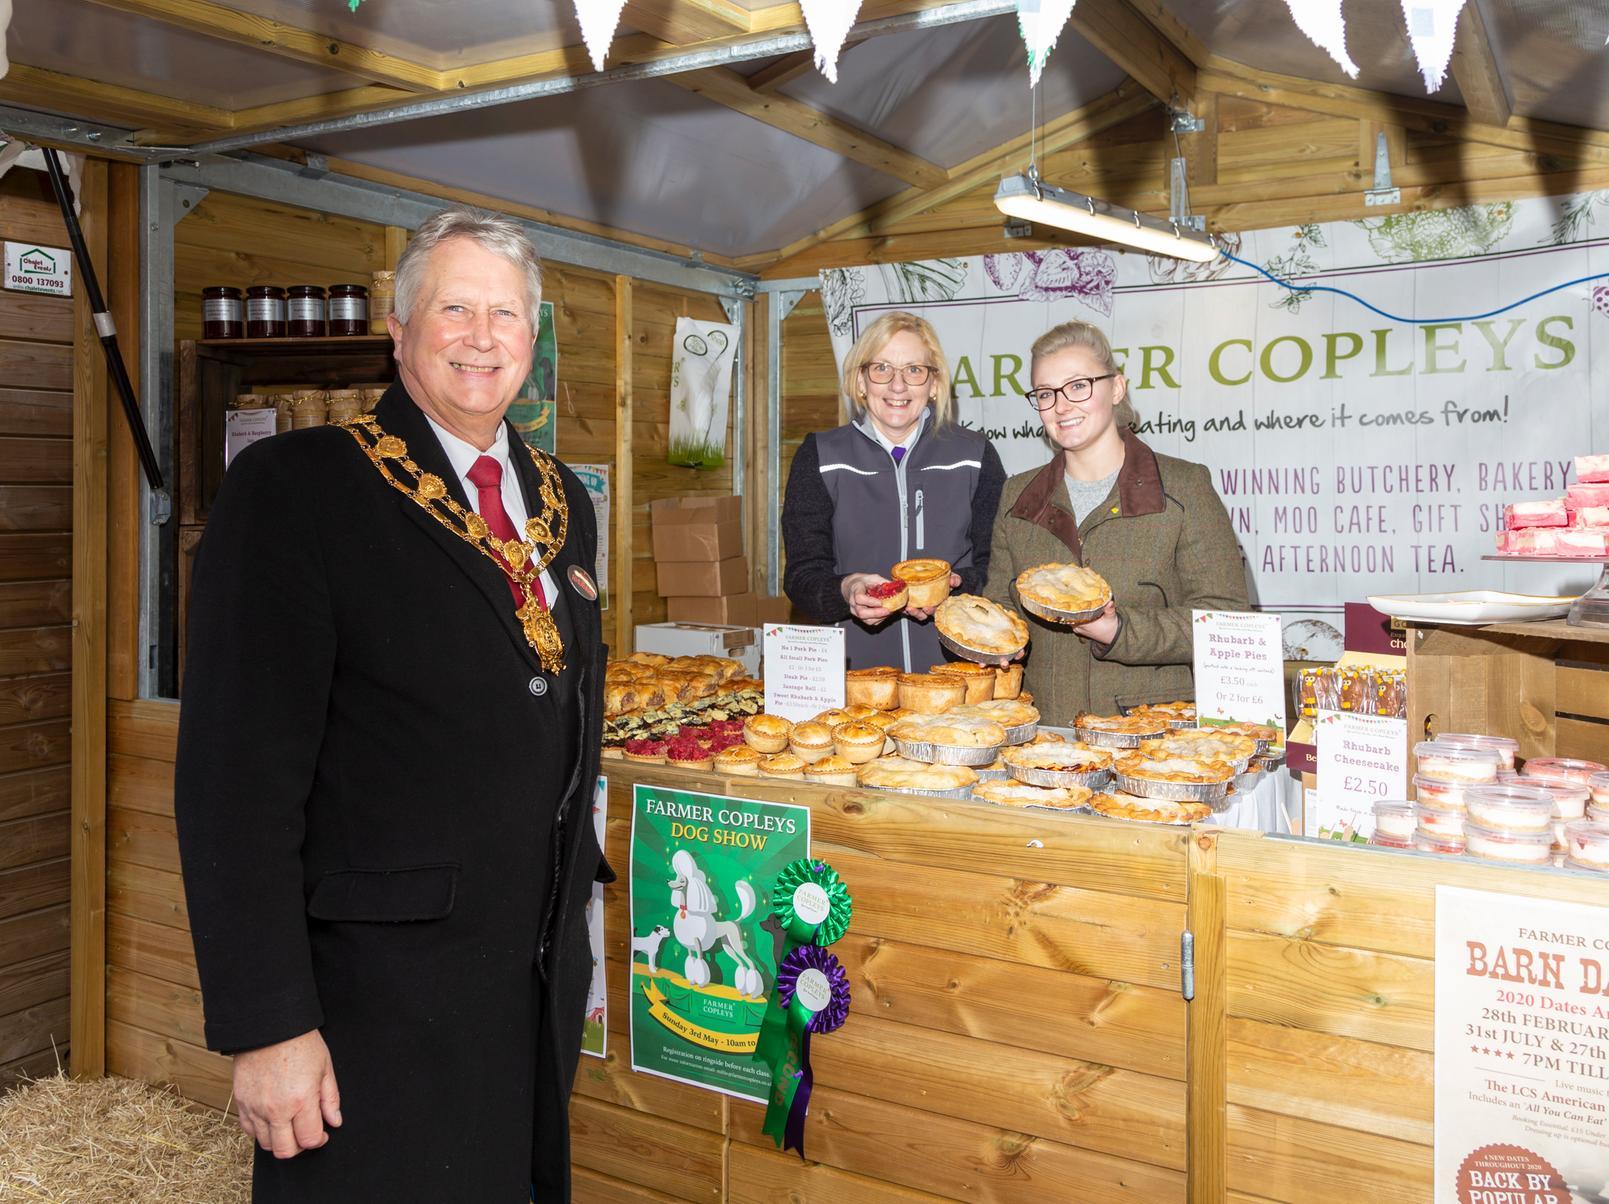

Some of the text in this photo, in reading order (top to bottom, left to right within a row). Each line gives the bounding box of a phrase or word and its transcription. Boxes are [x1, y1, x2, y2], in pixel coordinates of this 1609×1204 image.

[12, 275, 64, 288] 0800 137093
[1208, 315, 1576, 386] COPLEYS
[1128, 411, 1195, 442] eating
[1204, 410, 1246, 433] and
[1255, 409, 1325, 430] where
[1332, 403, 1352, 427] it
[1360, 408, 1434, 426] comes
[1441, 395, 1509, 424] from!
[1220, 466, 1320, 495] WINNING
[1478, 461, 1572, 492] BAKERY
[1274, 505, 1318, 534] MOO
[1334, 504, 1396, 535] CAFE,
[1412, 504, 1462, 533] GIFT
[1262, 545, 1394, 573] AFTERNOON
[1410, 544, 1464, 574] TEA.
[1208, 633, 1266, 646] Rhubarb &
[1210, 648, 1267, 660] Apple Pies
[1220, 676, 1244, 686] £3.50
[1216, 691, 1263, 704] Or 2 for £6
[1343, 740, 1391, 755] Rhubarb
[1334, 754, 1399, 772] Cheesecake
[1344, 776, 1388, 796] £2.50
[646, 798, 796, 834] FARMER COPLEYS
[671, 822, 768, 852] DOG SHOW
[1519, 927, 1587, 947] FARMER
[1466, 940, 1565, 990] BARN
[703, 998, 733, 1010] FARMER
[703, 1006, 733, 1018] COPLEYS
[1496, 990, 1535, 1007] 2020
[1540, 996, 1587, 1016] Dates
[662, 1012, 688, 1033] Sunday
[689, 1029, 702, 1039] 3rd
[703, 1034, 720, 1045] May
[726, 1039, 746, 1047] 10am
[1482, 1007, 1609, 1041] 28th FEBRUAR
[1465, 1024, 1607, 1060] 31st JULY & 27th
[663, 1046, 694, 1060] Registration
[703, 1056, 724, 1066] ringside
[725, 1061, 742, 1072] before
[742, 1066, 756, 1074] each
[1523, 1053, 1609, 1080] 7PM TILL
[1485, 1079, 1508, 1093] The
[1512, 1085, 1538, 1098] LCS
[1541, 1091, 1606, 1112] American
[1555, 1080, 1574, 1090] Live
[1576, 1085, 1606, 1097] music
[1468, 1091, 1507, 1107] Includes
[1509, 1101, 1521, 1109] an
[1543, 1106, 1561, 1118] You
[1563, 1111, 1584, 1122] Can
[1475, 1160, 1526, 1169] THROUGHOUT
[1469, 1170, 1552, 1191] BACK BY
[1469, 1190, 1559, 1204] POPULAR
